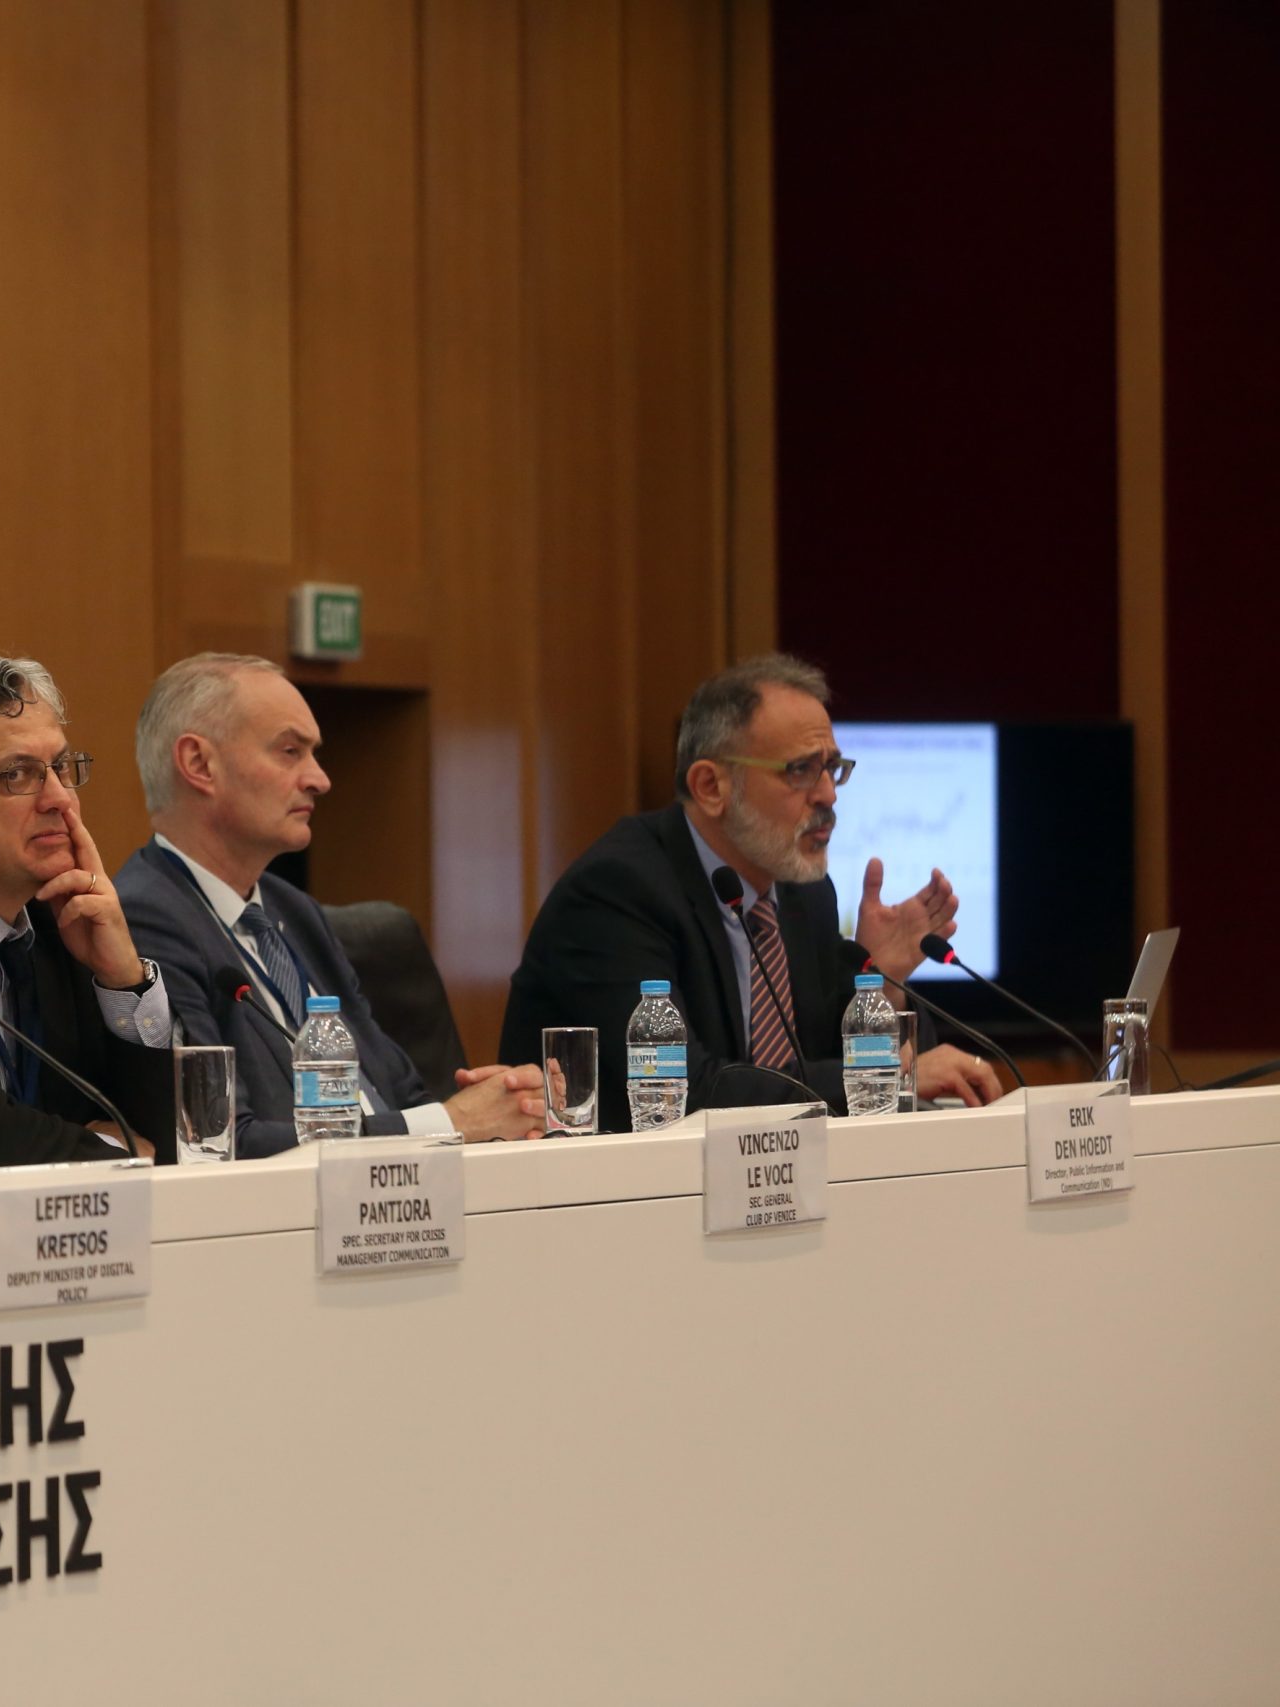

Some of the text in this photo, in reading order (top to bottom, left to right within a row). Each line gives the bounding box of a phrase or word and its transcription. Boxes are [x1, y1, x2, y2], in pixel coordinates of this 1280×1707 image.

[1069, 1105, 1095, 1128] ERIK
[738, 1129, 799, 1156] VINCENZO
[1055, 1134, 1112, 1160] DEN HOEDT
[369, 1163, 419, 1188] FOTINI
[747, 1162, 793, 1188] LE VOCI
[1069, 1164, 1085, 1177] Public
[1085, 1162, 1114, 1175] Information
[1115, 1161, 1125, 1171] and
[1061, 1180, 1100, 1194] Communication
[35, 1191, 110, 1222] LEFTERIS
[360, 1198, 432, 1225] PANTIORA
[764, 1192, 793, 1207] GENERAL
[746, 1209, 796, 1227] CLUB OF VENICE
[36, 1229, 108, 1260] KRETSOS
[364, 1231, 404, 1246] SECRETARY
[406, 1230, 420, 1243] FOR
[421, 1228, 446, 1242] CRISIS
[336, 1246, 450, 1267] MANAGEMENT COMMUNICATION
[7, 1261, 135, 1287] DEPUTY MINISTER OF DIGITAL
[57, 1286, 88, 1303] POLICY
